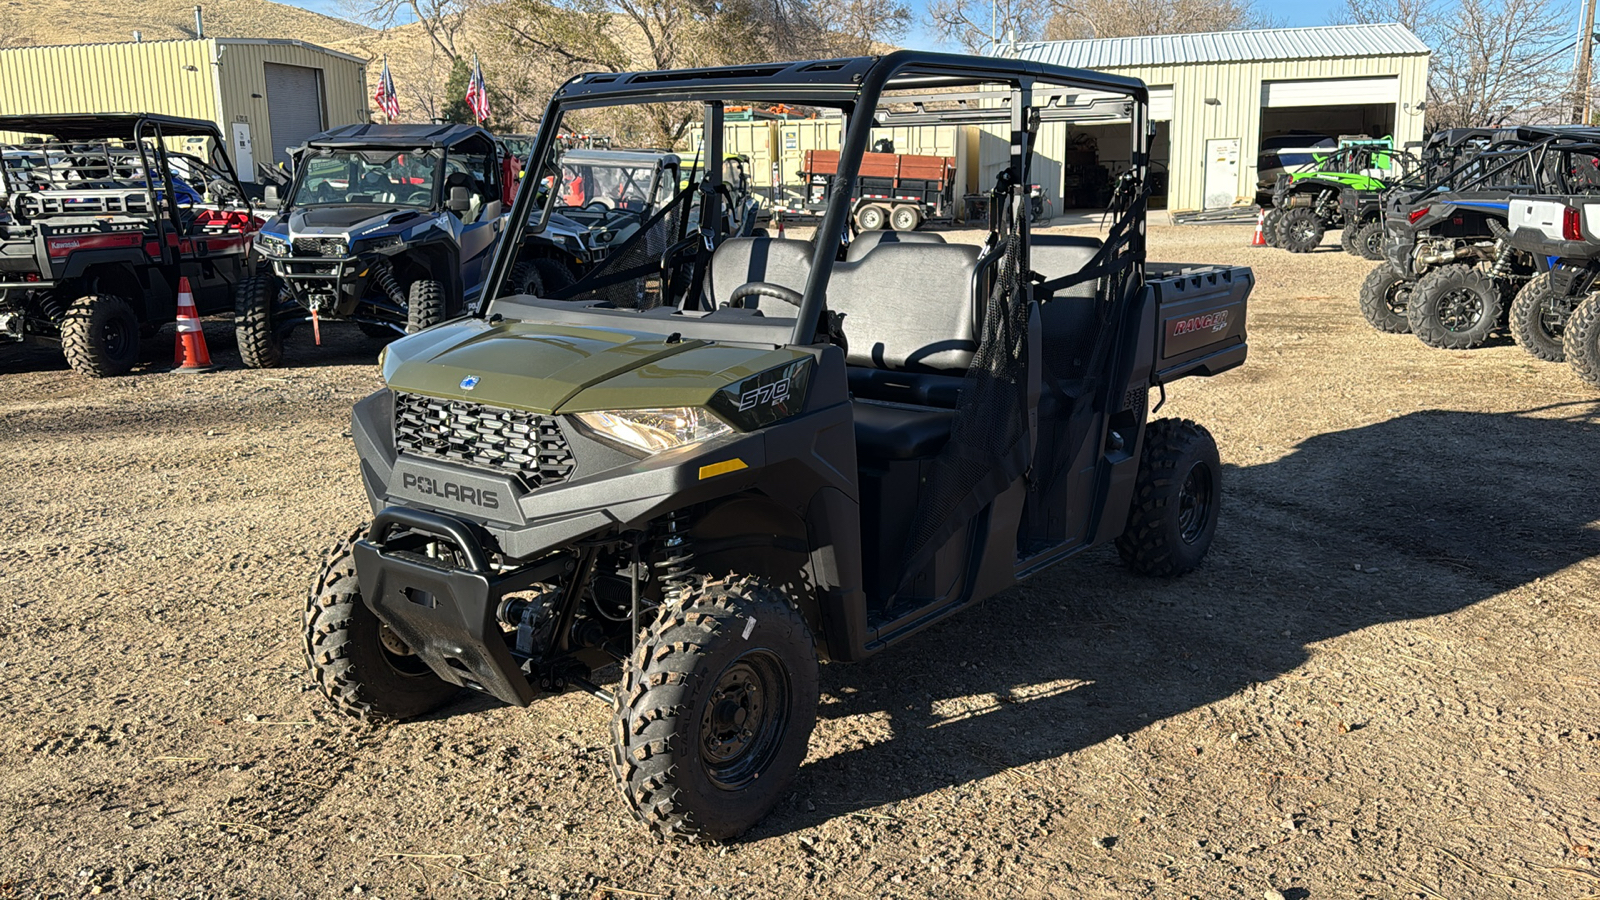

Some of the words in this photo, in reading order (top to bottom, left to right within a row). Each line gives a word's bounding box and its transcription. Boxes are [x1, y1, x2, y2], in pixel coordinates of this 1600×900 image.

[435, 216, 449, 226] XP
[51, 241, 80, 249] Kawasaki
[1173, 310, 1228, 336] RANGER
[1211, 322, 1227, 333] SP
[738, 377, 791, 412] 570
[402, 472, 499, 509] POLARIS
